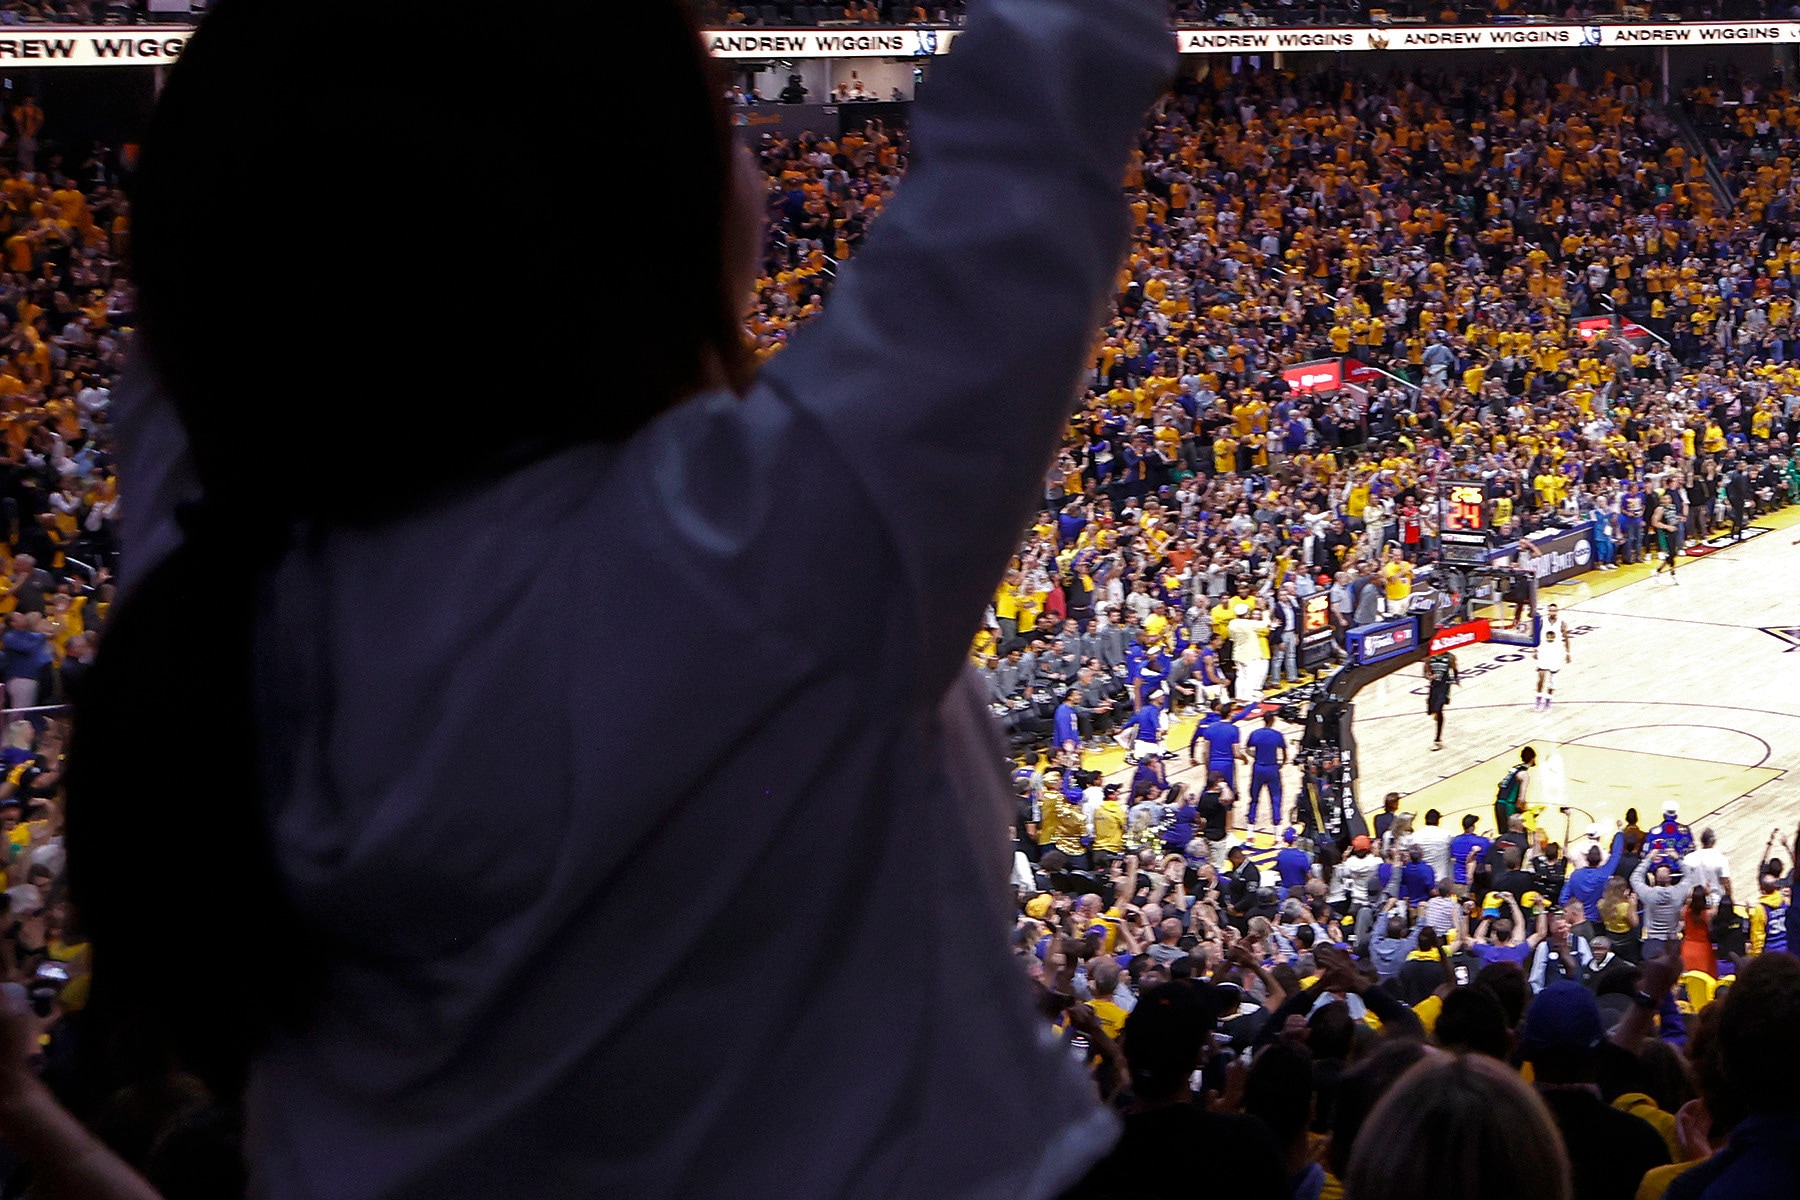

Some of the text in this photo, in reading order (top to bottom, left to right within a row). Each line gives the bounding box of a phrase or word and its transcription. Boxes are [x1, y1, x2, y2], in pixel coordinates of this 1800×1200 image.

[1188, 33, 1353, 48] ANDREW WIGGINS
[1404, 30, 1569, 45] ANDREW WIGGINS
[1615, 26, 1780, 42] ANDREW WIGGINS
[710, 35, 904, 52] ANDREW WIGGINS
[1446, 500, 1482, 530] 24
